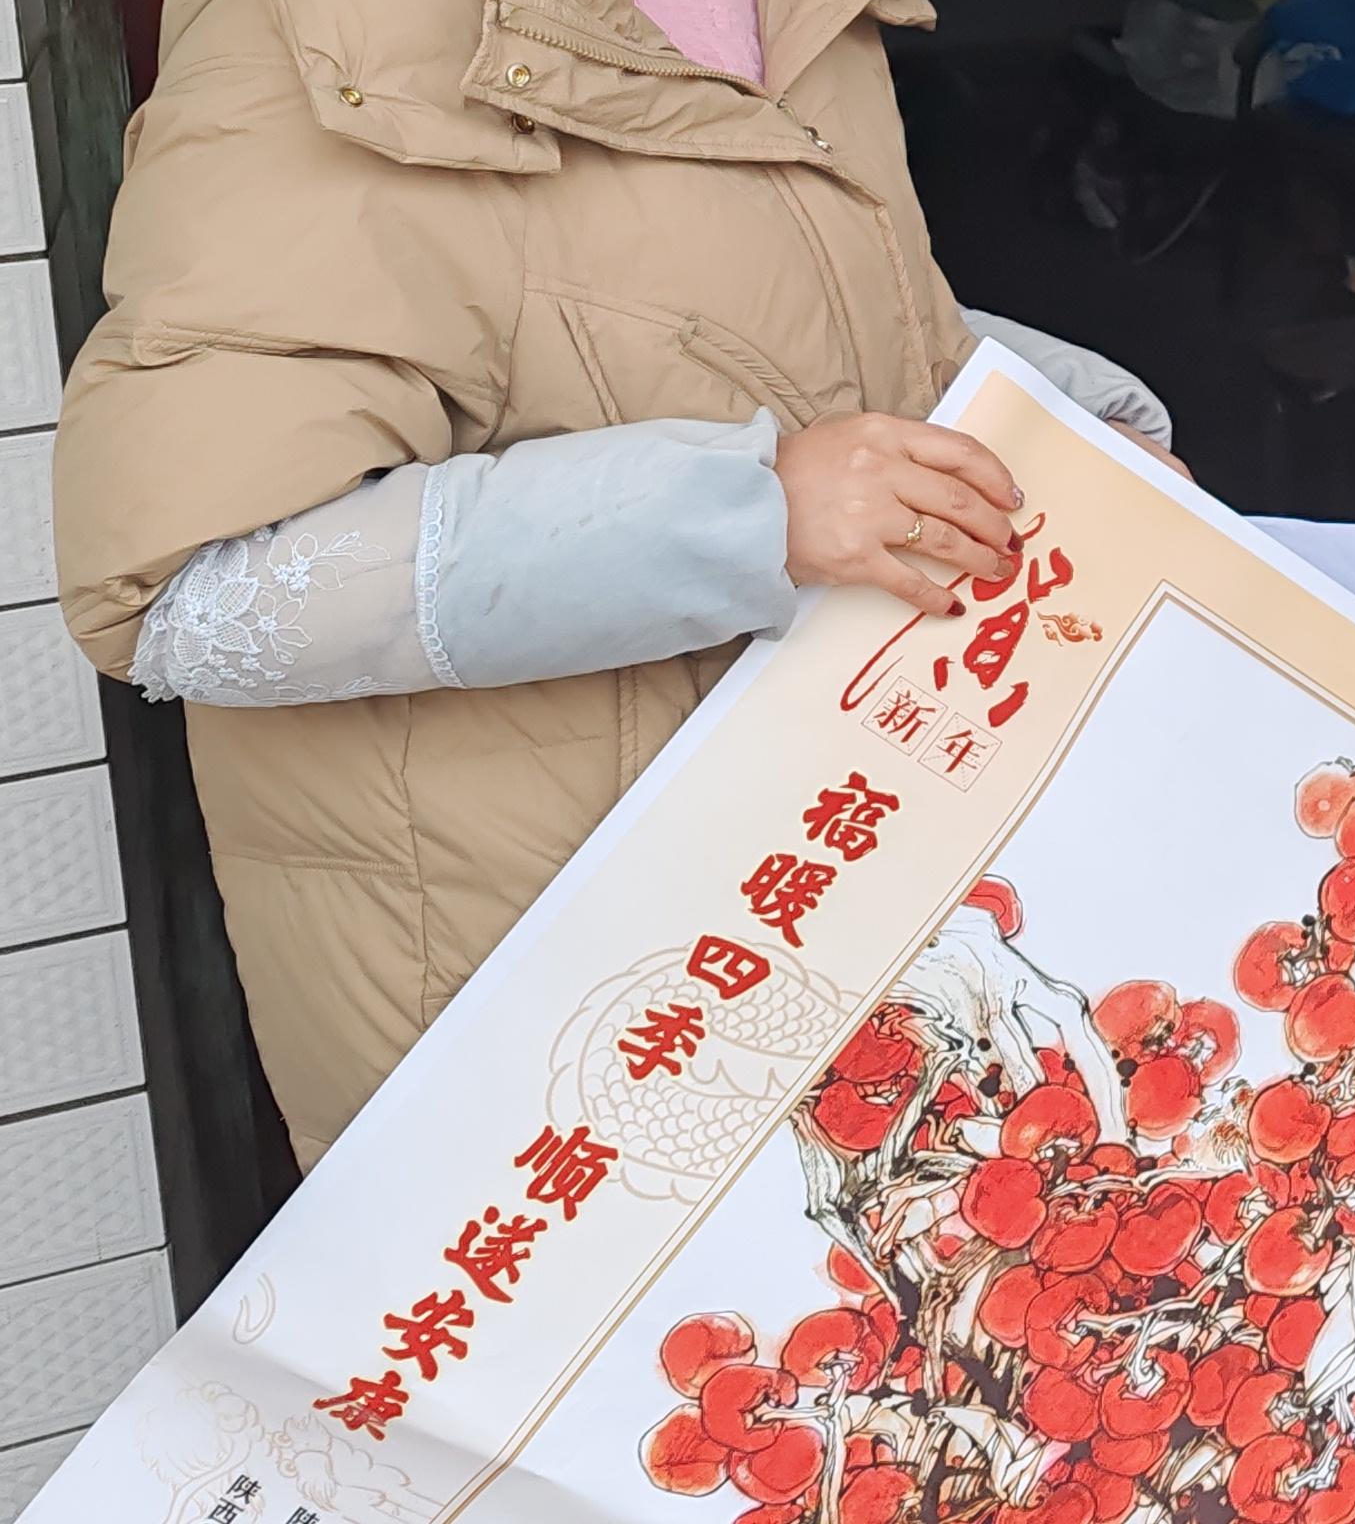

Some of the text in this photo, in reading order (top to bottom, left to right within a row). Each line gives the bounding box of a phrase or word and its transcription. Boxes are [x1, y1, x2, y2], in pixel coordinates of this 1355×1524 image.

[872, 689, 988, 774] 新年
[616, 770, 900, 1081] 福暖四季
[312, 1125, 619, 1442] 顺遂安康
